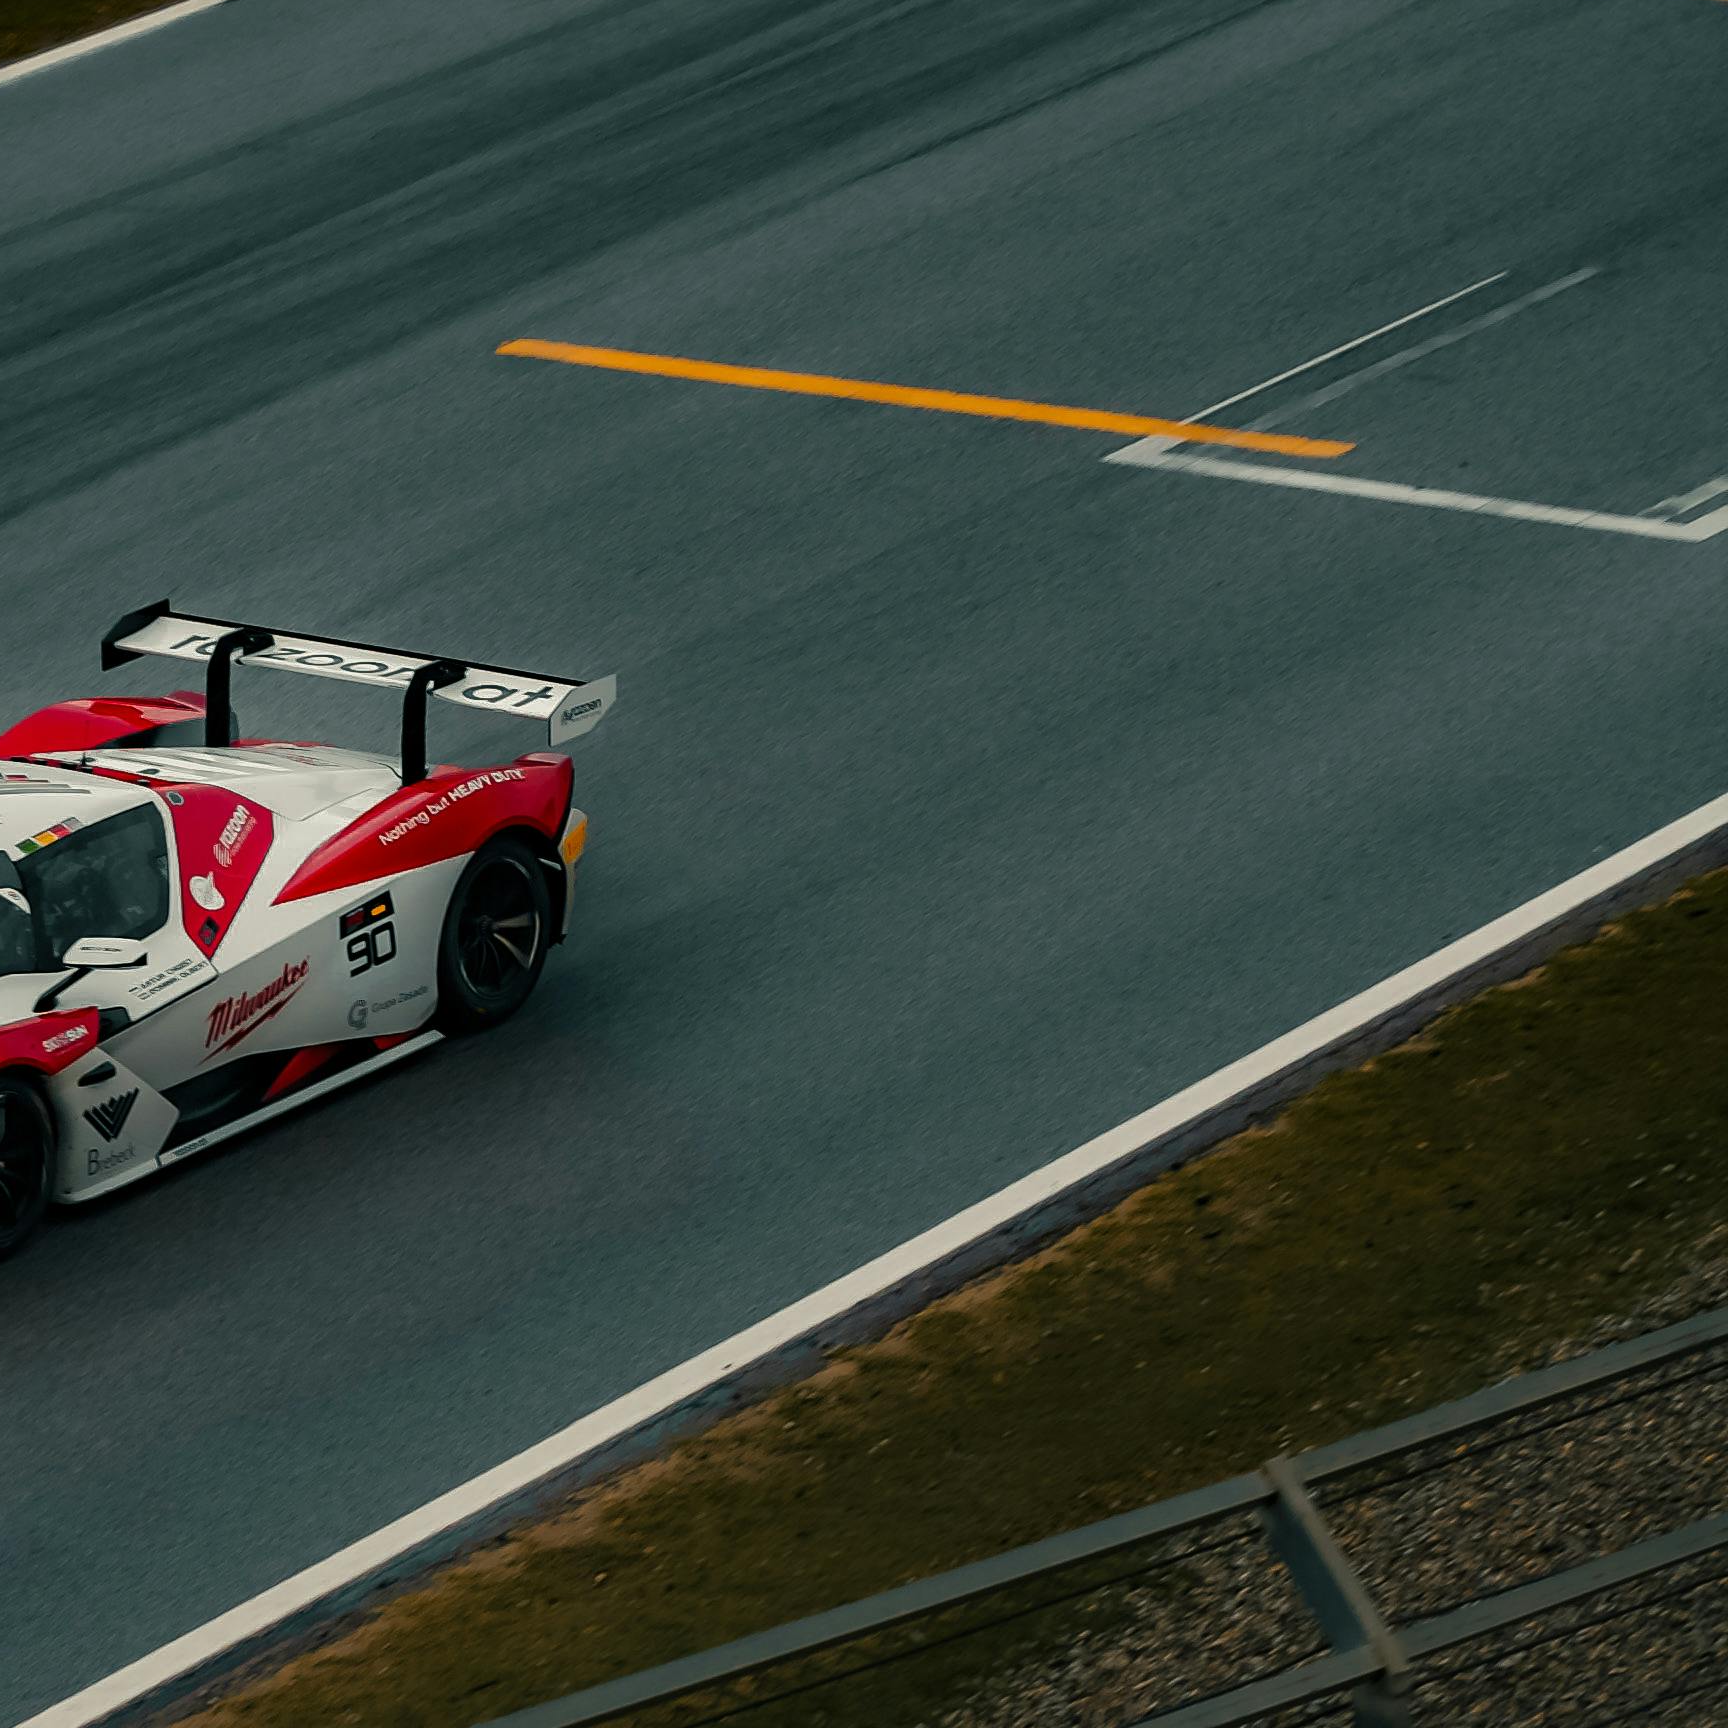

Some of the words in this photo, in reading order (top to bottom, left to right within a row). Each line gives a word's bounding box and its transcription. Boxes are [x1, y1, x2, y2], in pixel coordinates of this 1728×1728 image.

[378, 810, 430, 846] Nothing
[426, 796, 451, 815] but
[448, 774, 492, 801] HEAVY
[347, 921, 397, 977] 90
[206, 959, 308, 1048] Milwaukee
